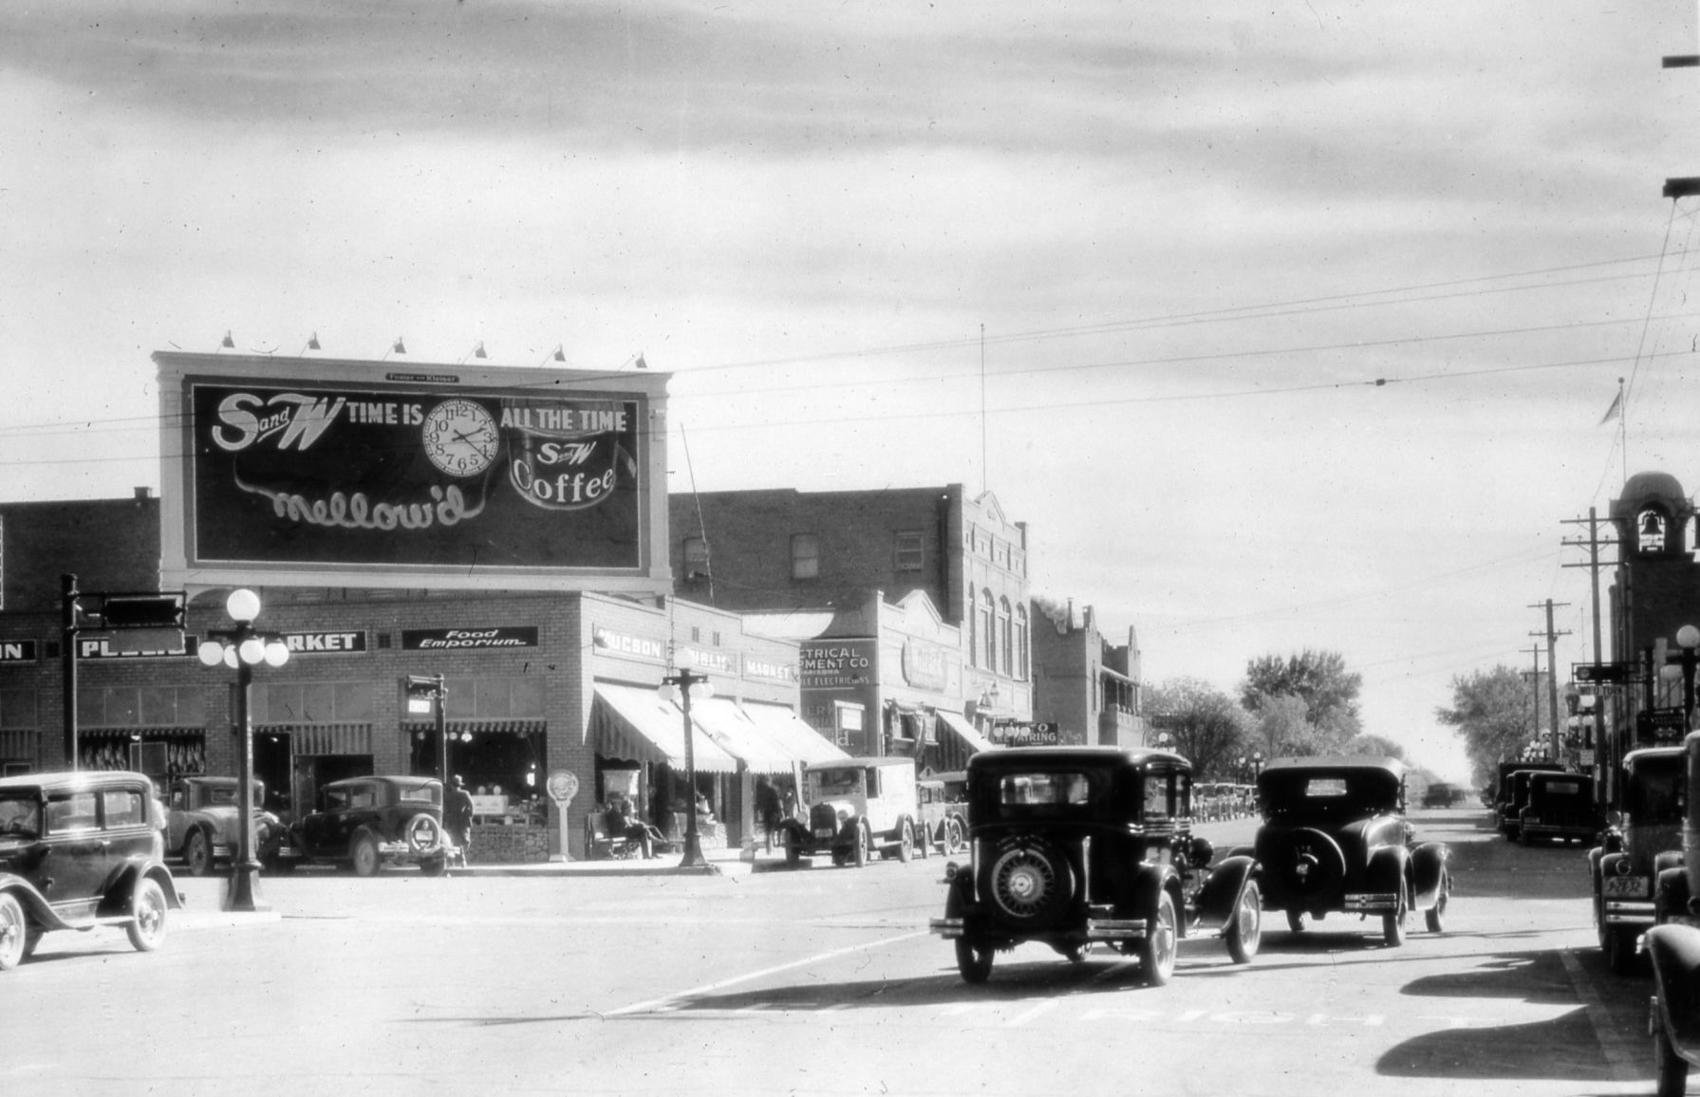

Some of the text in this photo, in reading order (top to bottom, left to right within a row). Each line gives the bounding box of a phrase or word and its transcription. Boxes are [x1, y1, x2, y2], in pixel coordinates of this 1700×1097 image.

[346, 401, 398, 425] TIME
[402, 403, 424, 426] IS
[445, 408, 455, 421] 11
[456, 404, 468, 417] 12
[471, 410, 477, 422] 1
[435, 419, 449, 433] 10
[500, 407, 628, 432] ALL THE TIME
[429, 431, 440, 443] 9
[483, 431, 493, 444] 3
[435, 444, 445, 456] 8
[446, 453, 455, 465] 7
[457, 457, 467, 470] 6
[470, 453, 479, 466] 5
[513, 468, 615, 503] Coffee
[446, 629, 499, 639] Food
[260, 633, 357, 652] RKET
[419, 638, 524, 649] Emporium
[849, 657, 869, 669] CO
